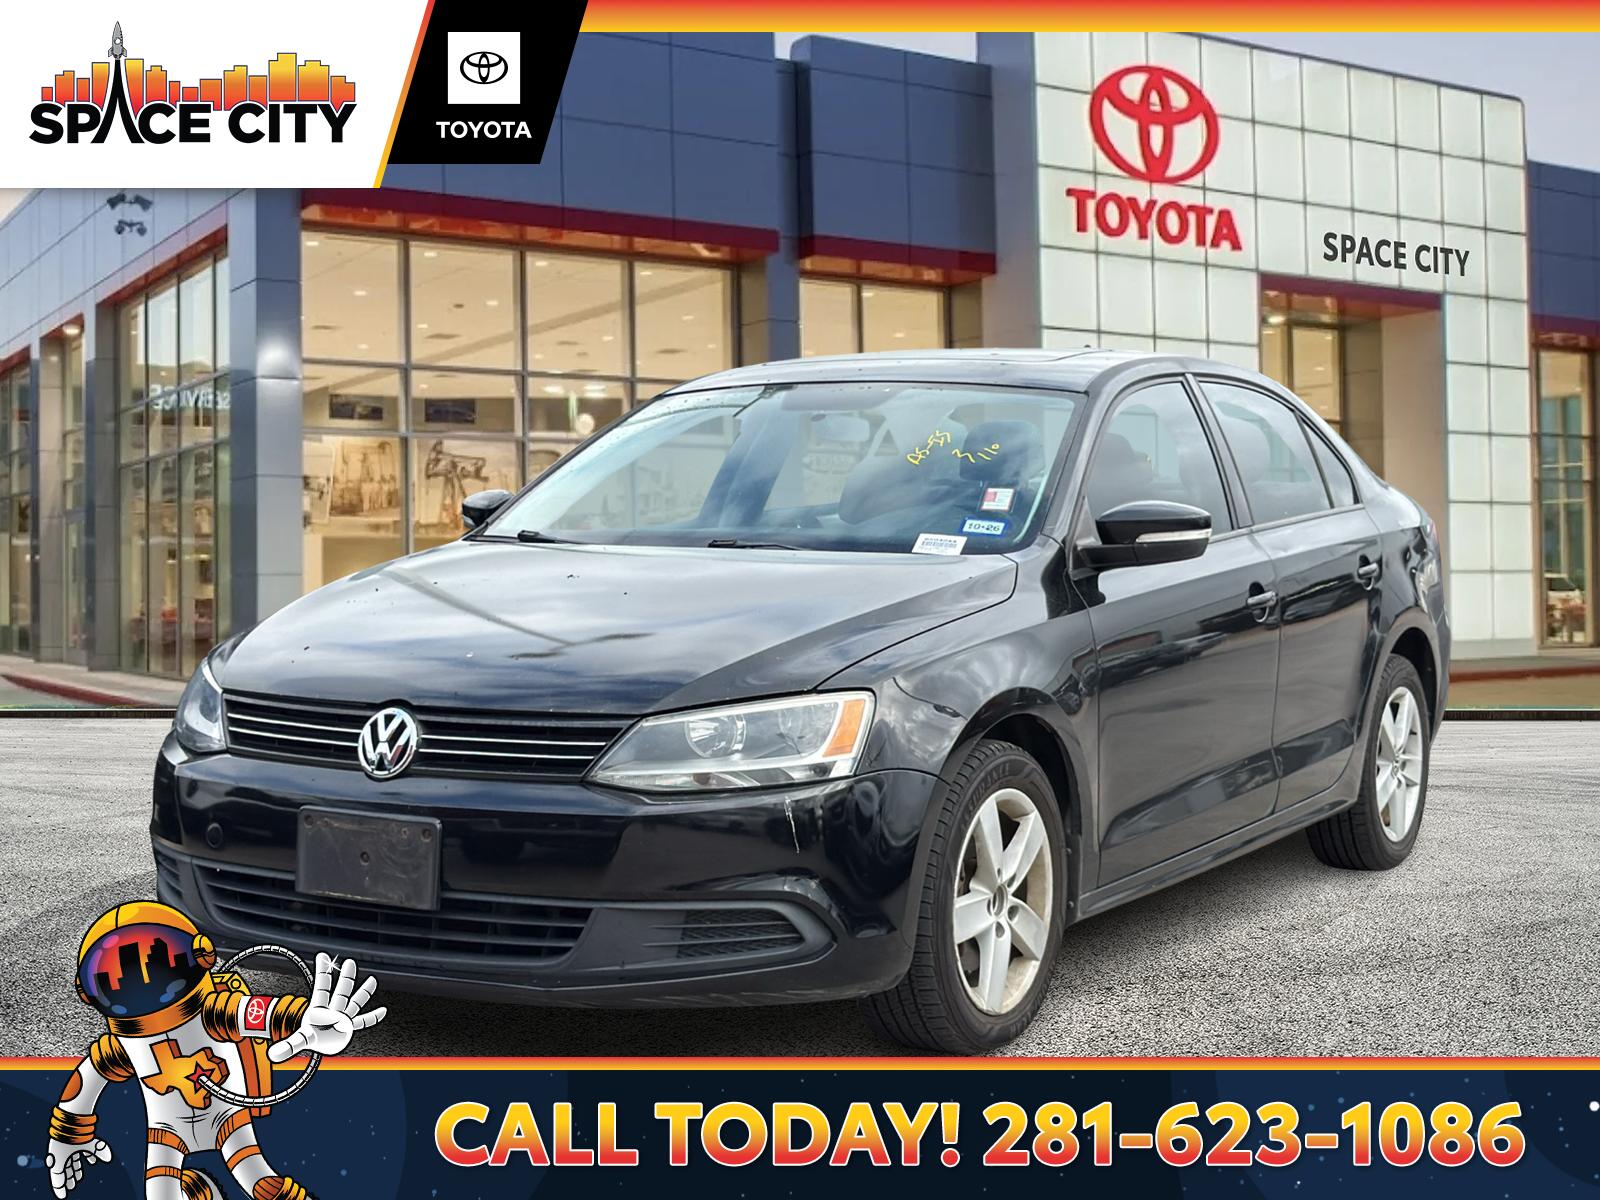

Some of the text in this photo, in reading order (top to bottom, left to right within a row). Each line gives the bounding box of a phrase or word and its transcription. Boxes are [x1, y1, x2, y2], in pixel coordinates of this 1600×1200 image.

[1065, 187, 1243, 252] TOYOTA
[1322, 231, 1471, 278] SPACE CITY
